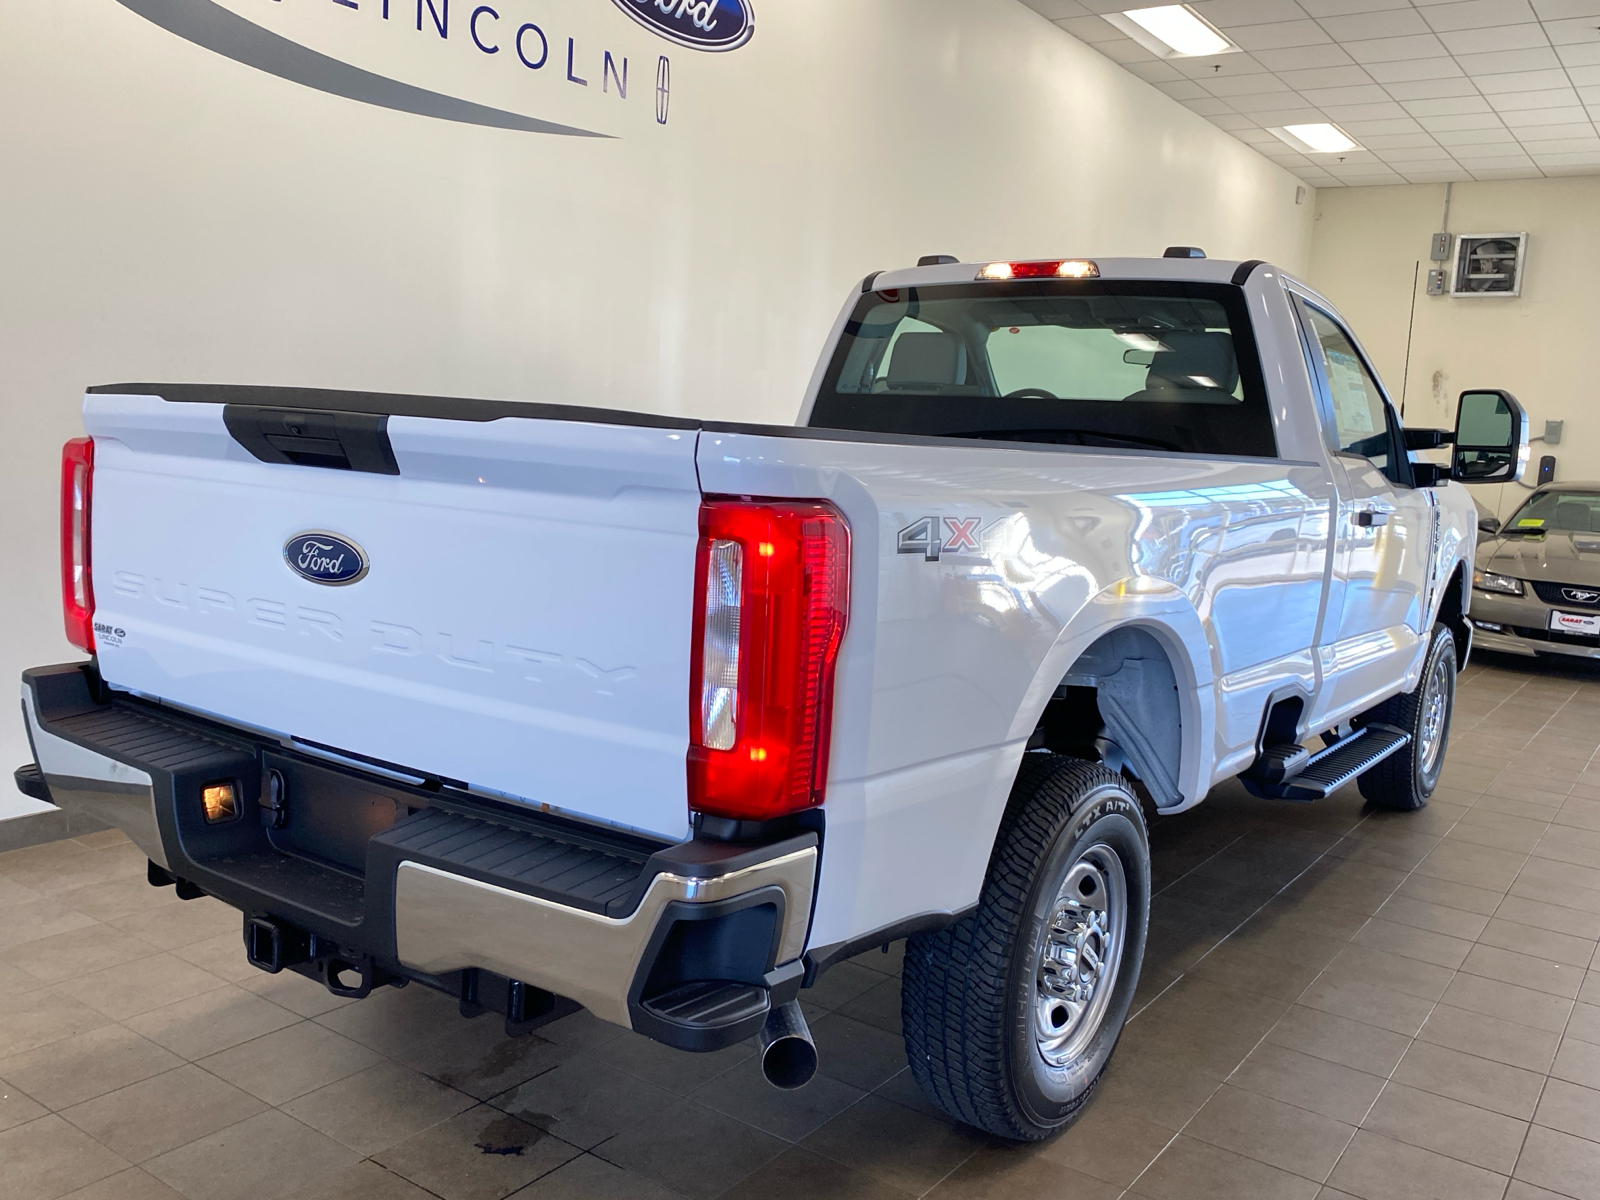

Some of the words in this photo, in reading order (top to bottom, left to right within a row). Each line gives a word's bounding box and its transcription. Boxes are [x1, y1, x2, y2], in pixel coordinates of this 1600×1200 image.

[634, 0, 718, 32] ord
[332, 0, 628, 99] NCOLN
[298, 540, 345, 575] Ford
[113, 570, 344, 643] SUPER
[370, 620, 638, 696] DUTY
[1074, 806, 1102, 839] LTX
